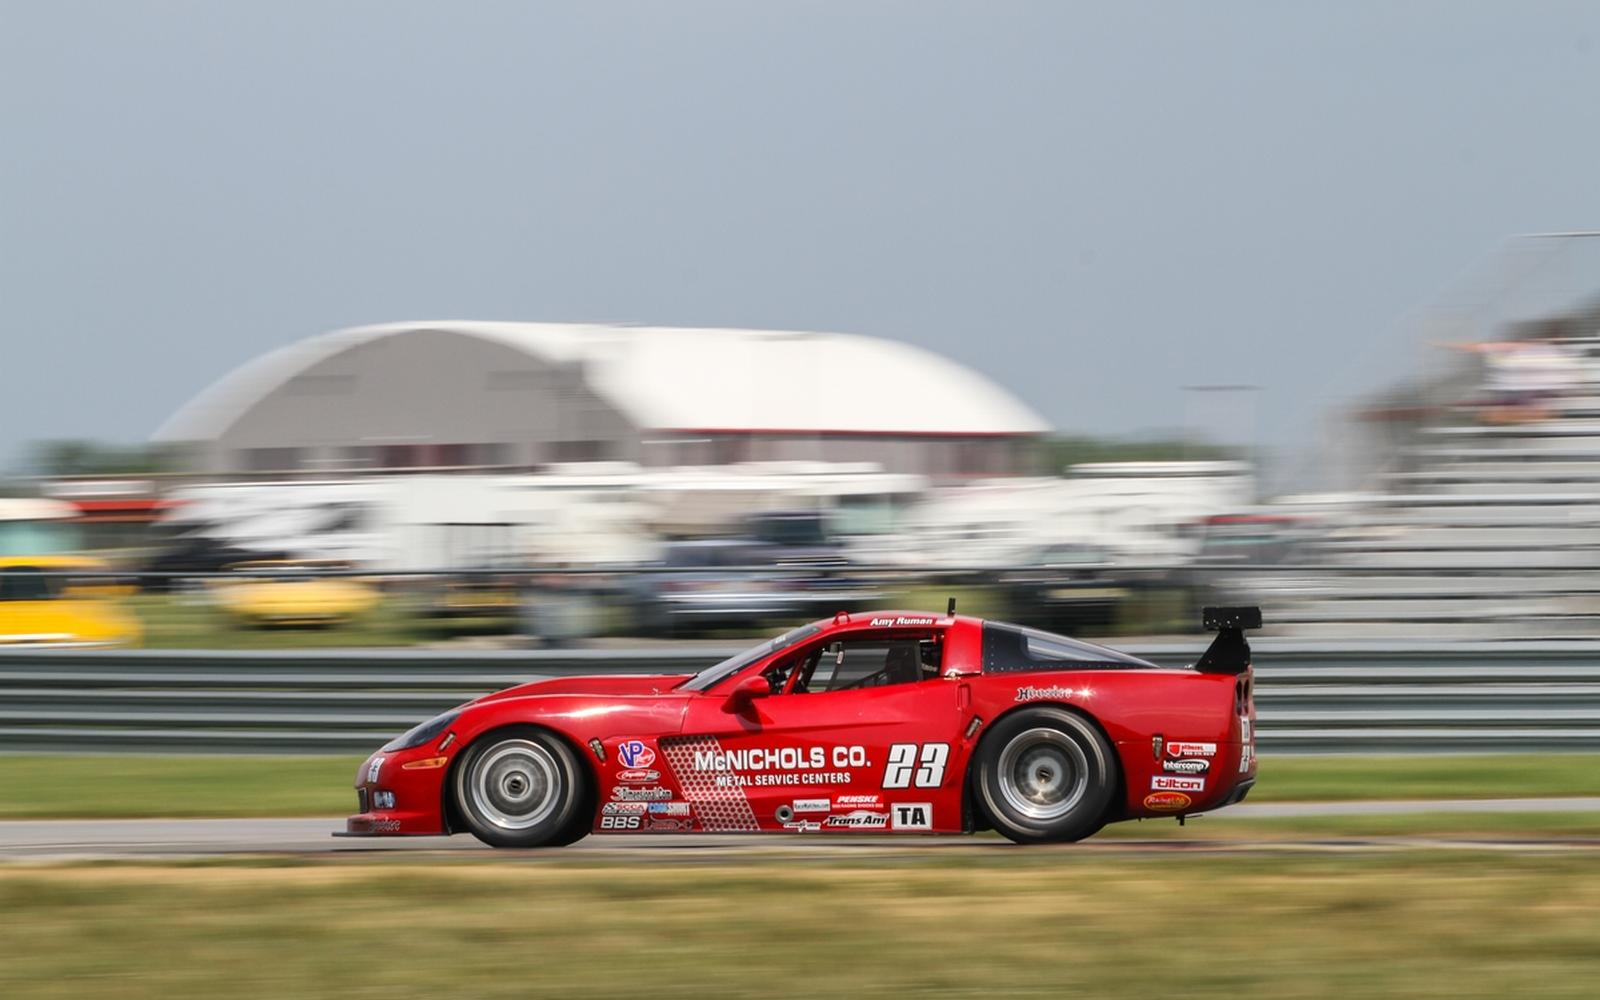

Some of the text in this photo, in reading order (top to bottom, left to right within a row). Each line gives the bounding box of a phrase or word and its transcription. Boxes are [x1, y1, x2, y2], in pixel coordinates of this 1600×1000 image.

[870, 617, 933, 627] Amy Ruman
[618, 740, 645, 768] VP
[694, 746, 872, 771] McNICHOLS CO.
[881, 743, 950, 789] 23
[716, 772, 851, 787] METAL SERVICE CENTERS
[1155, 779, 1201, 789] tilton
[837, 795, 879, 803] PENSKE
[600, 816, 640, 829] BBS
[828, 816, 861, 825] Trans
[862, 815, 885, 825] Am
[897, 807, 926, 825] TA
